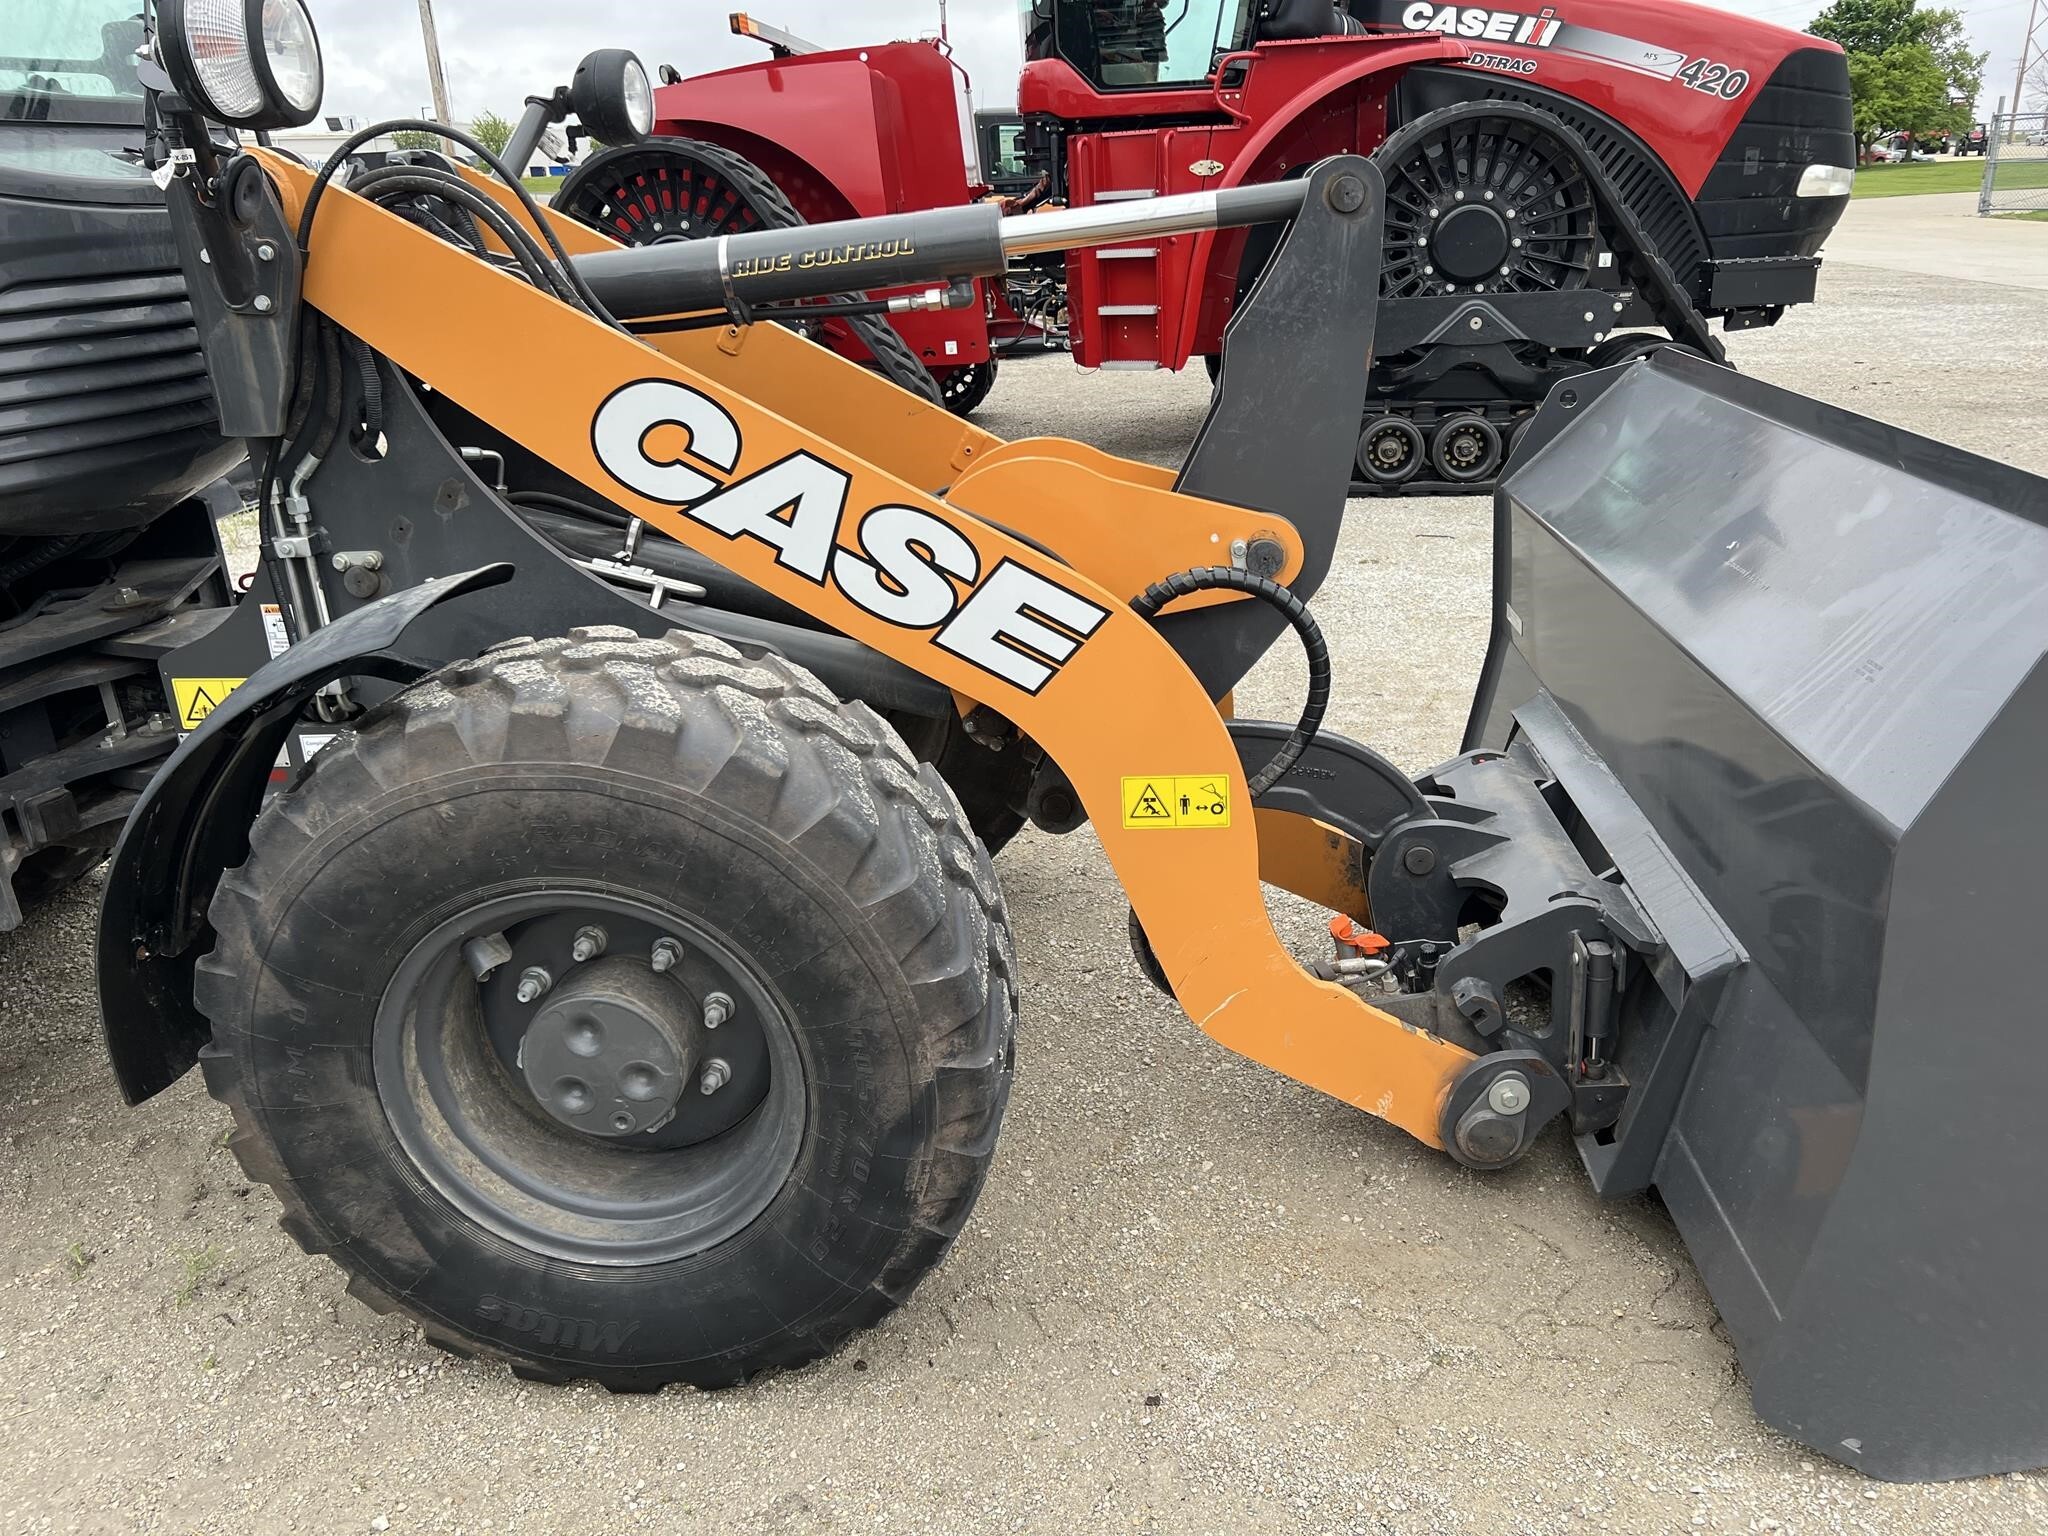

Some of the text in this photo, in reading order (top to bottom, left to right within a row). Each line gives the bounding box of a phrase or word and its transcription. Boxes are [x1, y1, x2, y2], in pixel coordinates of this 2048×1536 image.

[1402, 2, 1520, 42] CASE
[1459, 52, 1538, 75] DTRAC
[1644, 52, 1659, 61] AFS
[1676, 57, 1750, 100] 420
[732, 237, 915, 278] RIDE CONTROL
[591, 377, 1111, 695] CASE
